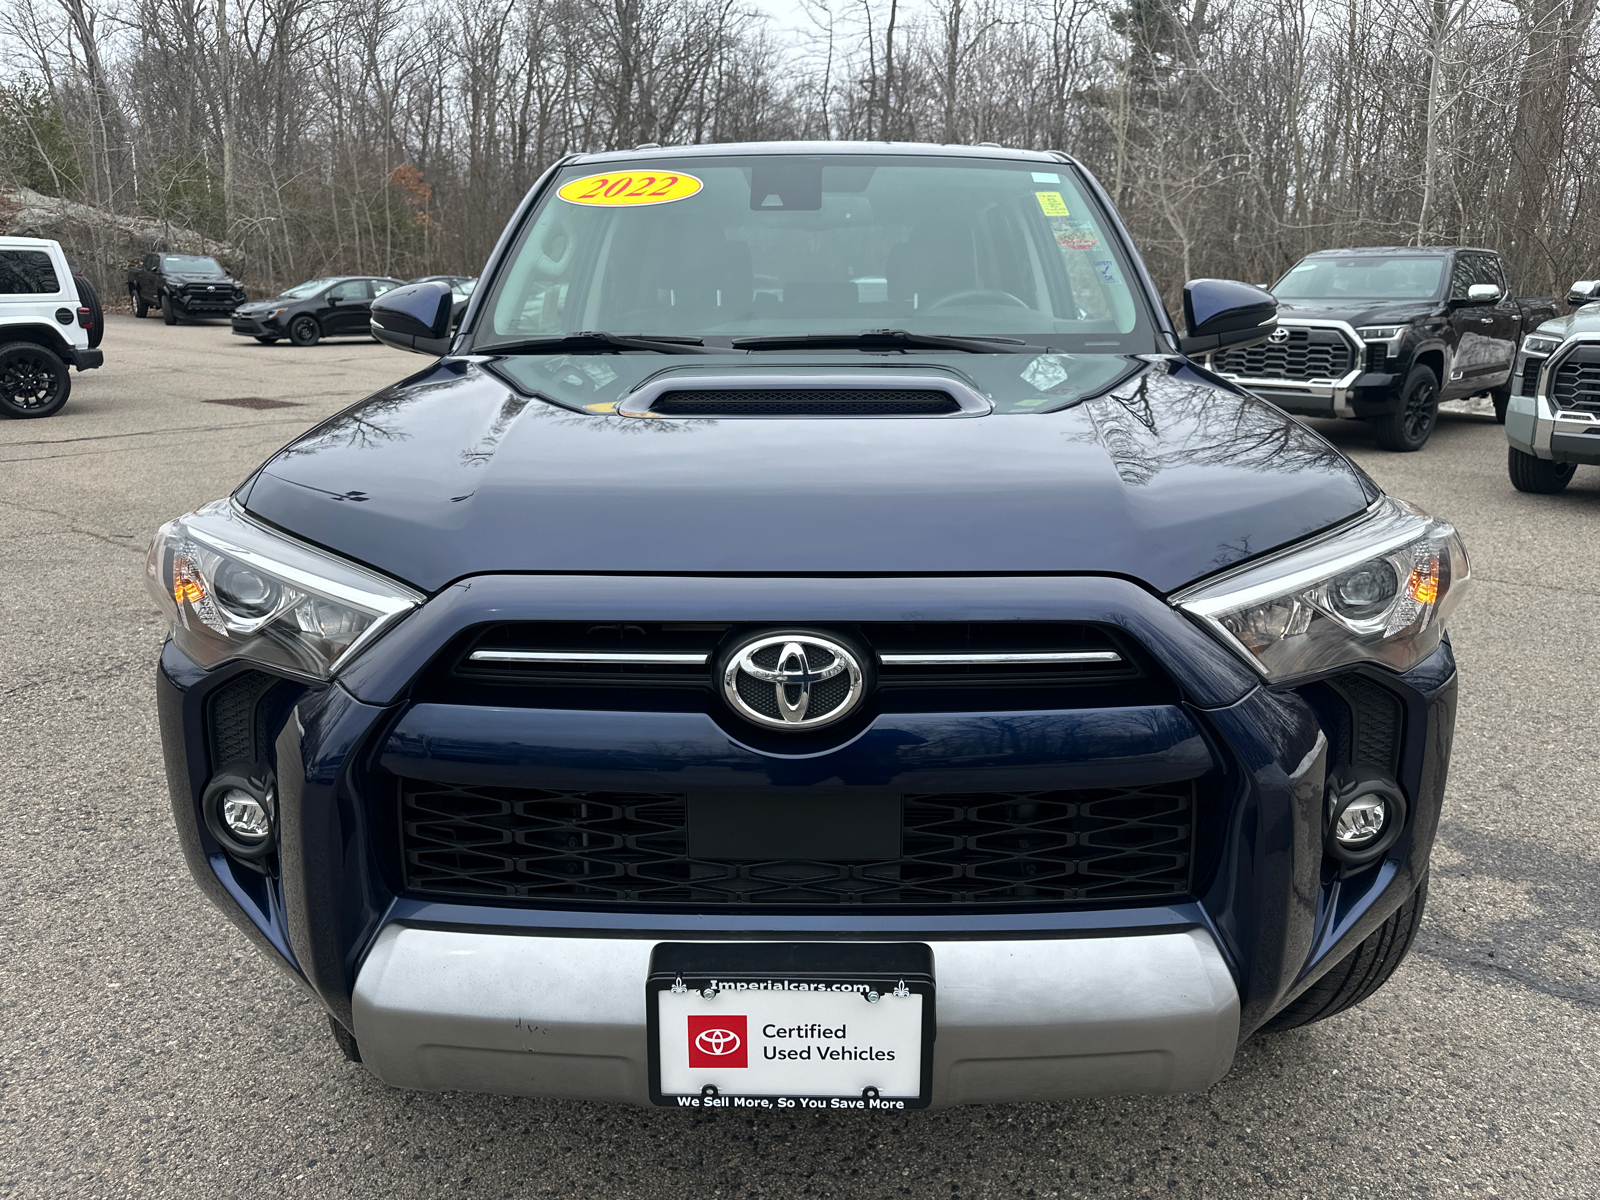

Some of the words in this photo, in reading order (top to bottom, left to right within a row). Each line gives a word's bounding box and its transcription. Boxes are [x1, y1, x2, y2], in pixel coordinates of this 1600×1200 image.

[577, 176, 679, 199] 2022
[710, 979, 870, 993] Imperialcars.com
[762, 1023, 847, 1039] Certified
[763, 1046, 812, 1061] Used
[816, 1046, 896, 1061] Vehicles
[677, 1096, 700, 1108] We
[703, 1096, 730, 1108] Sell
[734, 1097, 774, 1110] More,
[777, 1098, 795, 1109] So
[799, 1098, 827, 1109] You
[830, 1098, 865, 1110] Save
[868, 1099, 905, 1110] More
